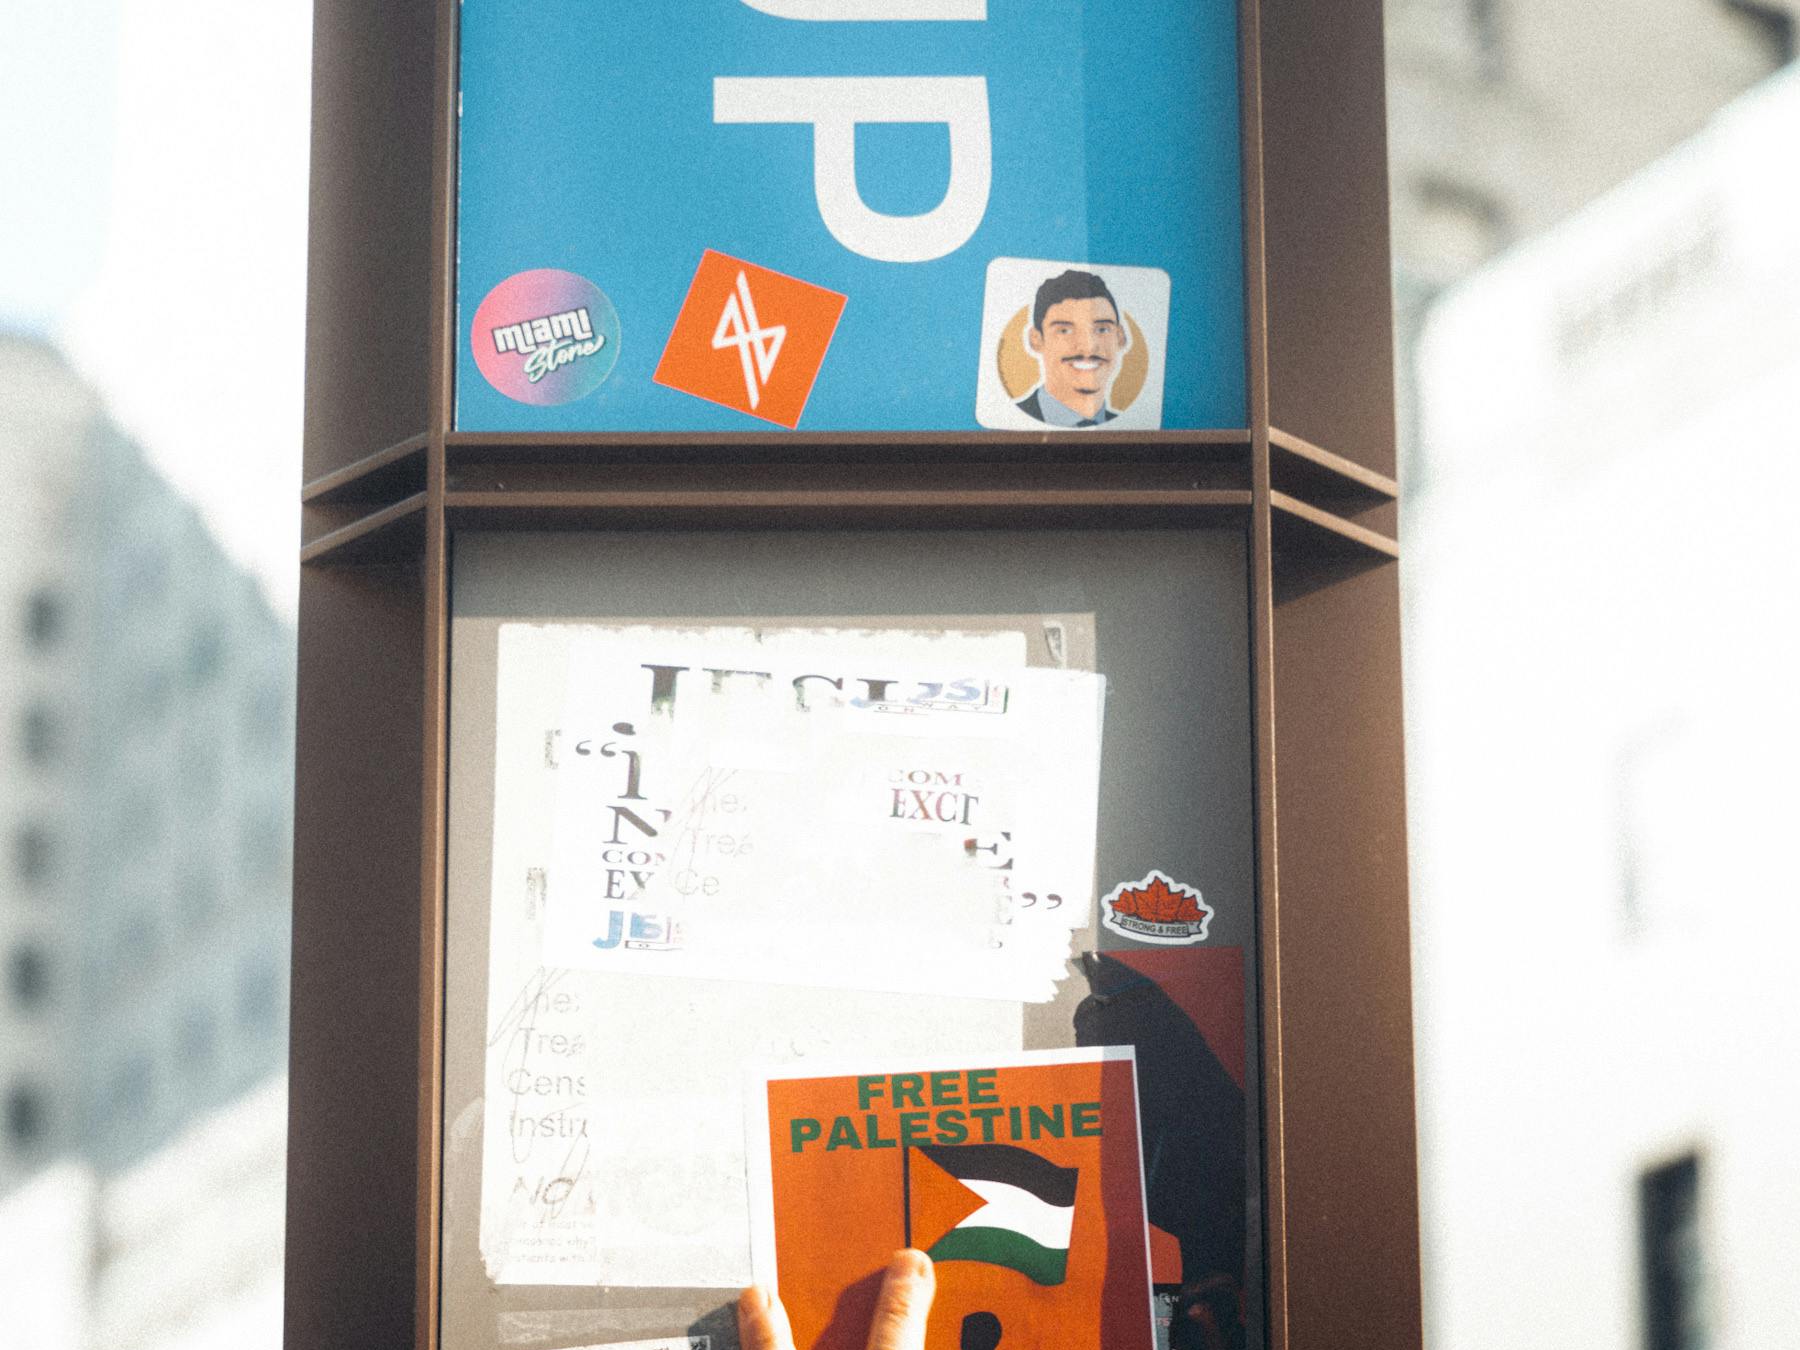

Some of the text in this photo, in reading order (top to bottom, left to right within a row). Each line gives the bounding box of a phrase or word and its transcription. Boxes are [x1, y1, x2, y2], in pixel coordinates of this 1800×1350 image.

[713, 0, 993, 263] P
[1122, 919, 1188, 936] STRONG & FREE
[858, 1069, 1000, 1110] FREE
[790, 1102, 1102, 1153] PALESTINE
